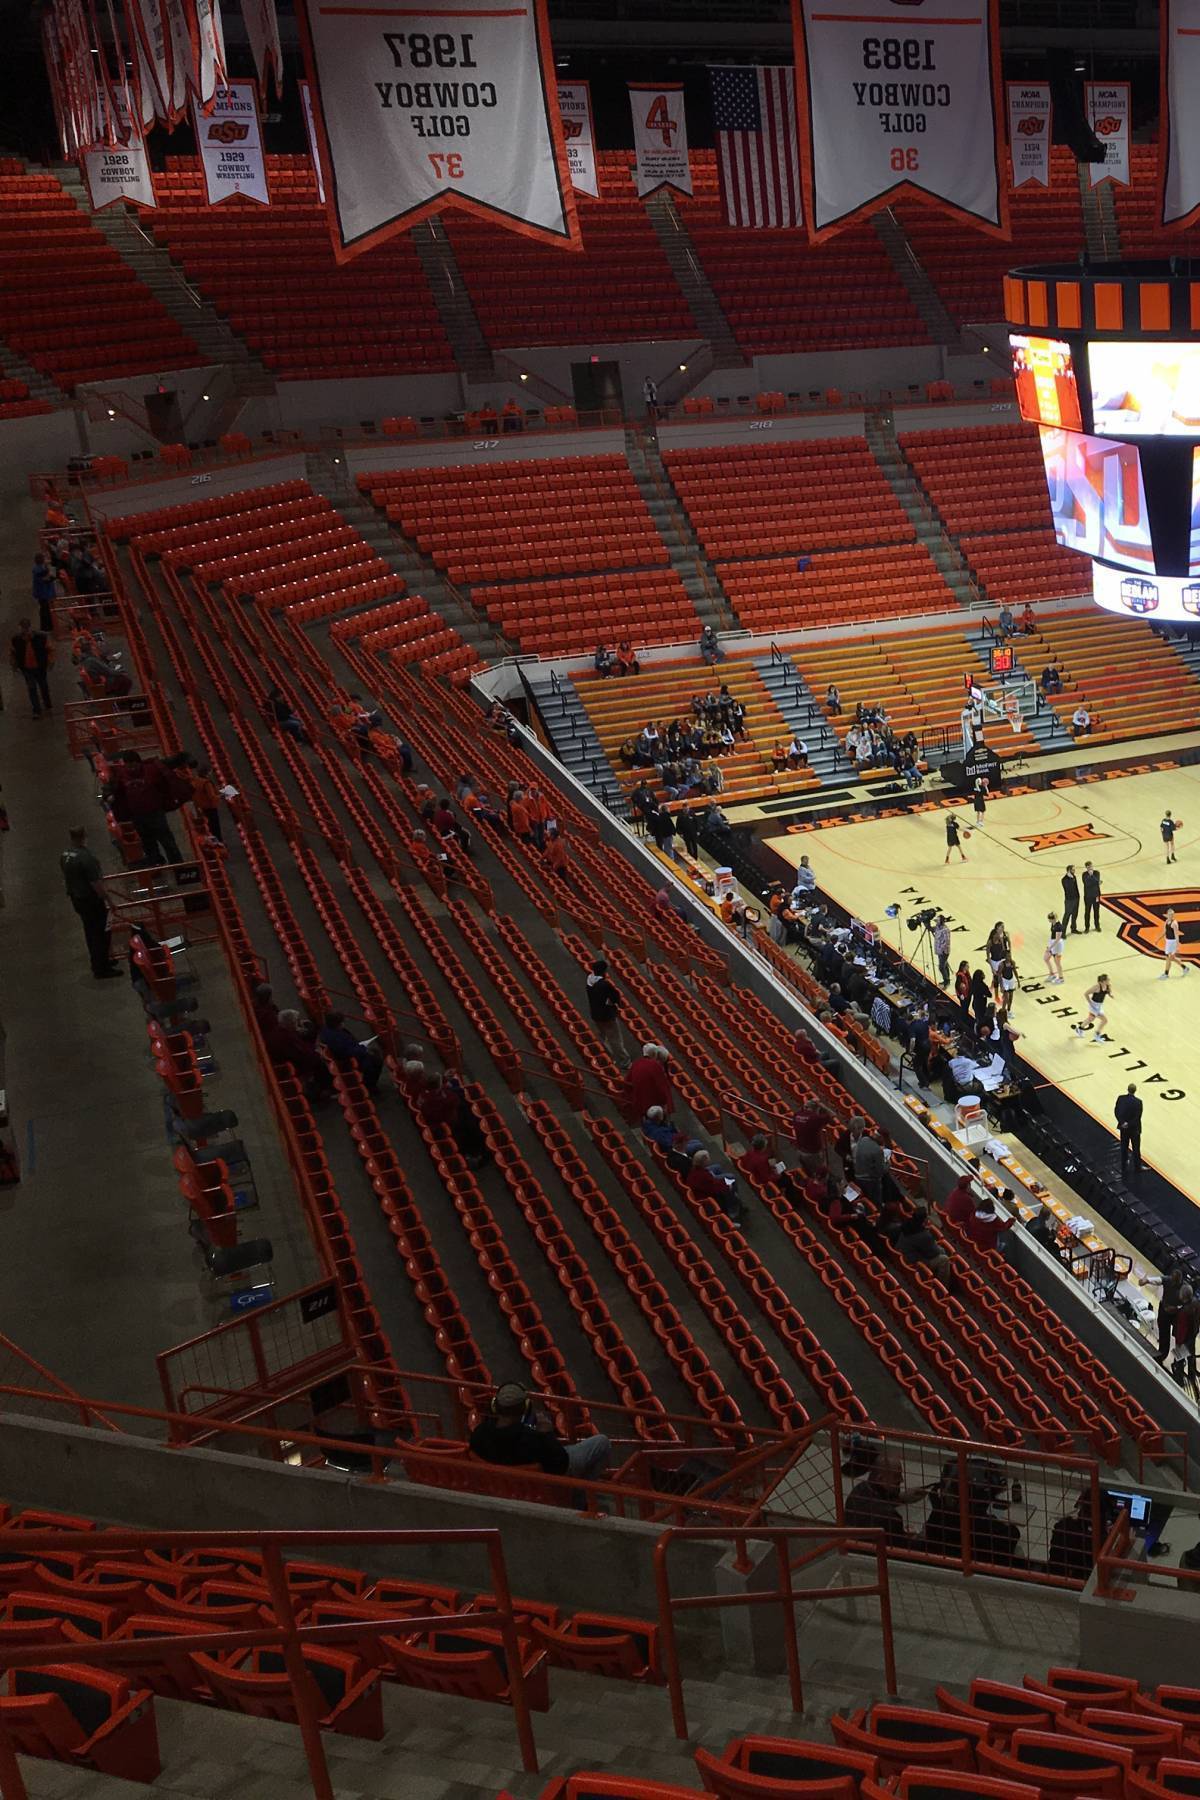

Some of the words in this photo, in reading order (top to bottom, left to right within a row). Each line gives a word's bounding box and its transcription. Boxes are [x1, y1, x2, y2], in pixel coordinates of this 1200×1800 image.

[645, 95, 678, 148] 4
[103, 155, 129, 165] 1928
[220, 152, 245, 162] 1929
[101, 168, 135, 176] COWBOY
[217, 164, 251, 172] COWBOY
[101, 175, 140, 183] WRESTLING
[216, 172, 255, 180] WRESTLING
[474, 440, 499, 450] 217
[192, 473, 212, 485] 216
[1050, 760, 1180, 788] STATE
[308, 1295, 328, 1312] 211
